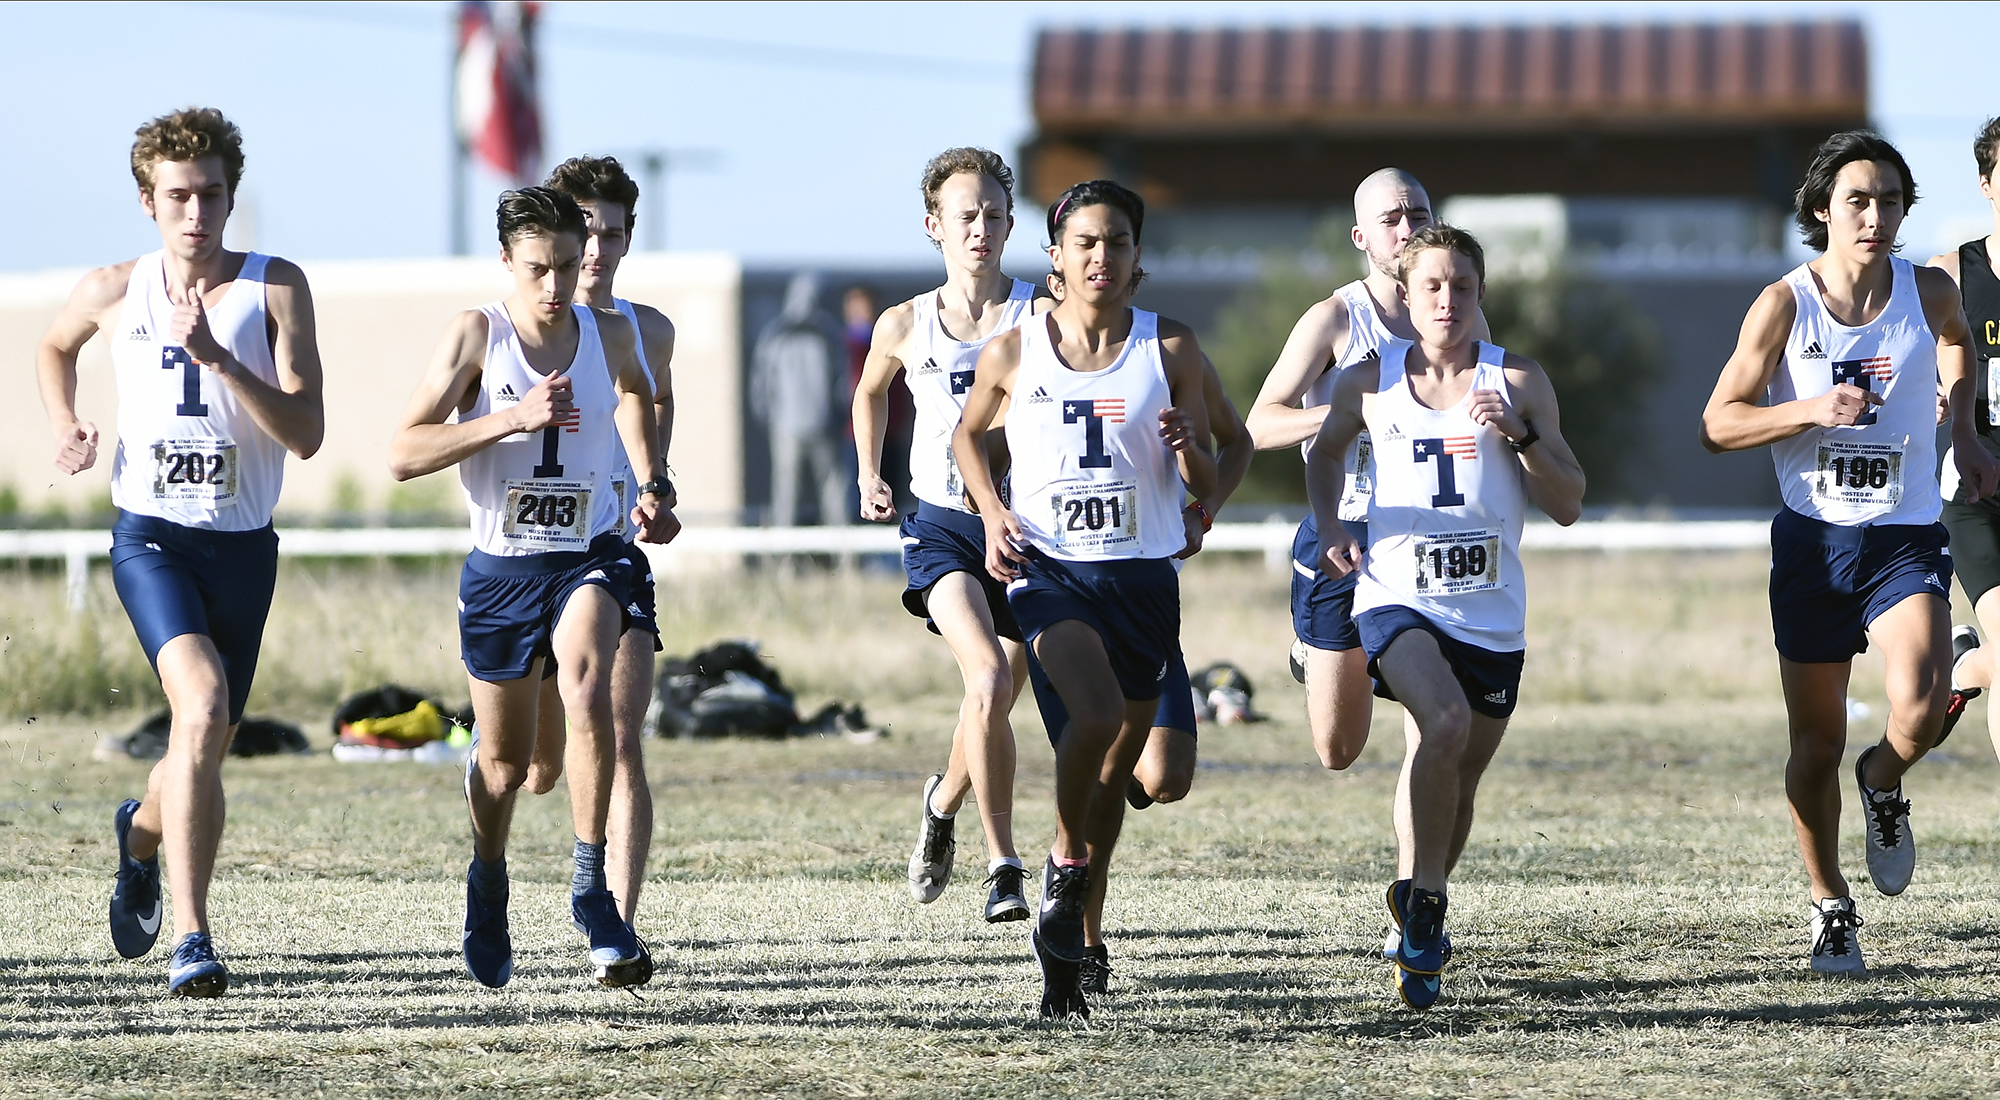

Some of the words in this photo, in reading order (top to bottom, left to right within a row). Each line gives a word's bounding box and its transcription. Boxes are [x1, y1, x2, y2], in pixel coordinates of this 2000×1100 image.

[1063, 398, 1126, 469] T
[166, 452, 224, 485] 202
[1413, 436, 1477, 508] T
[1831, 456, 1889, 489] 196
[517, 494, 577, 528] 203
[1064, 495, 1121, 532] 201
[528, 528, 552, 536] HOSTED
[548, 535, 585, 543] UNIVERSITY
[1102, 536, 1137, 545] UNIVERSITY
[1428, 544, 1487, 580] 199
[1484, 694, 1507, 704] adidas
